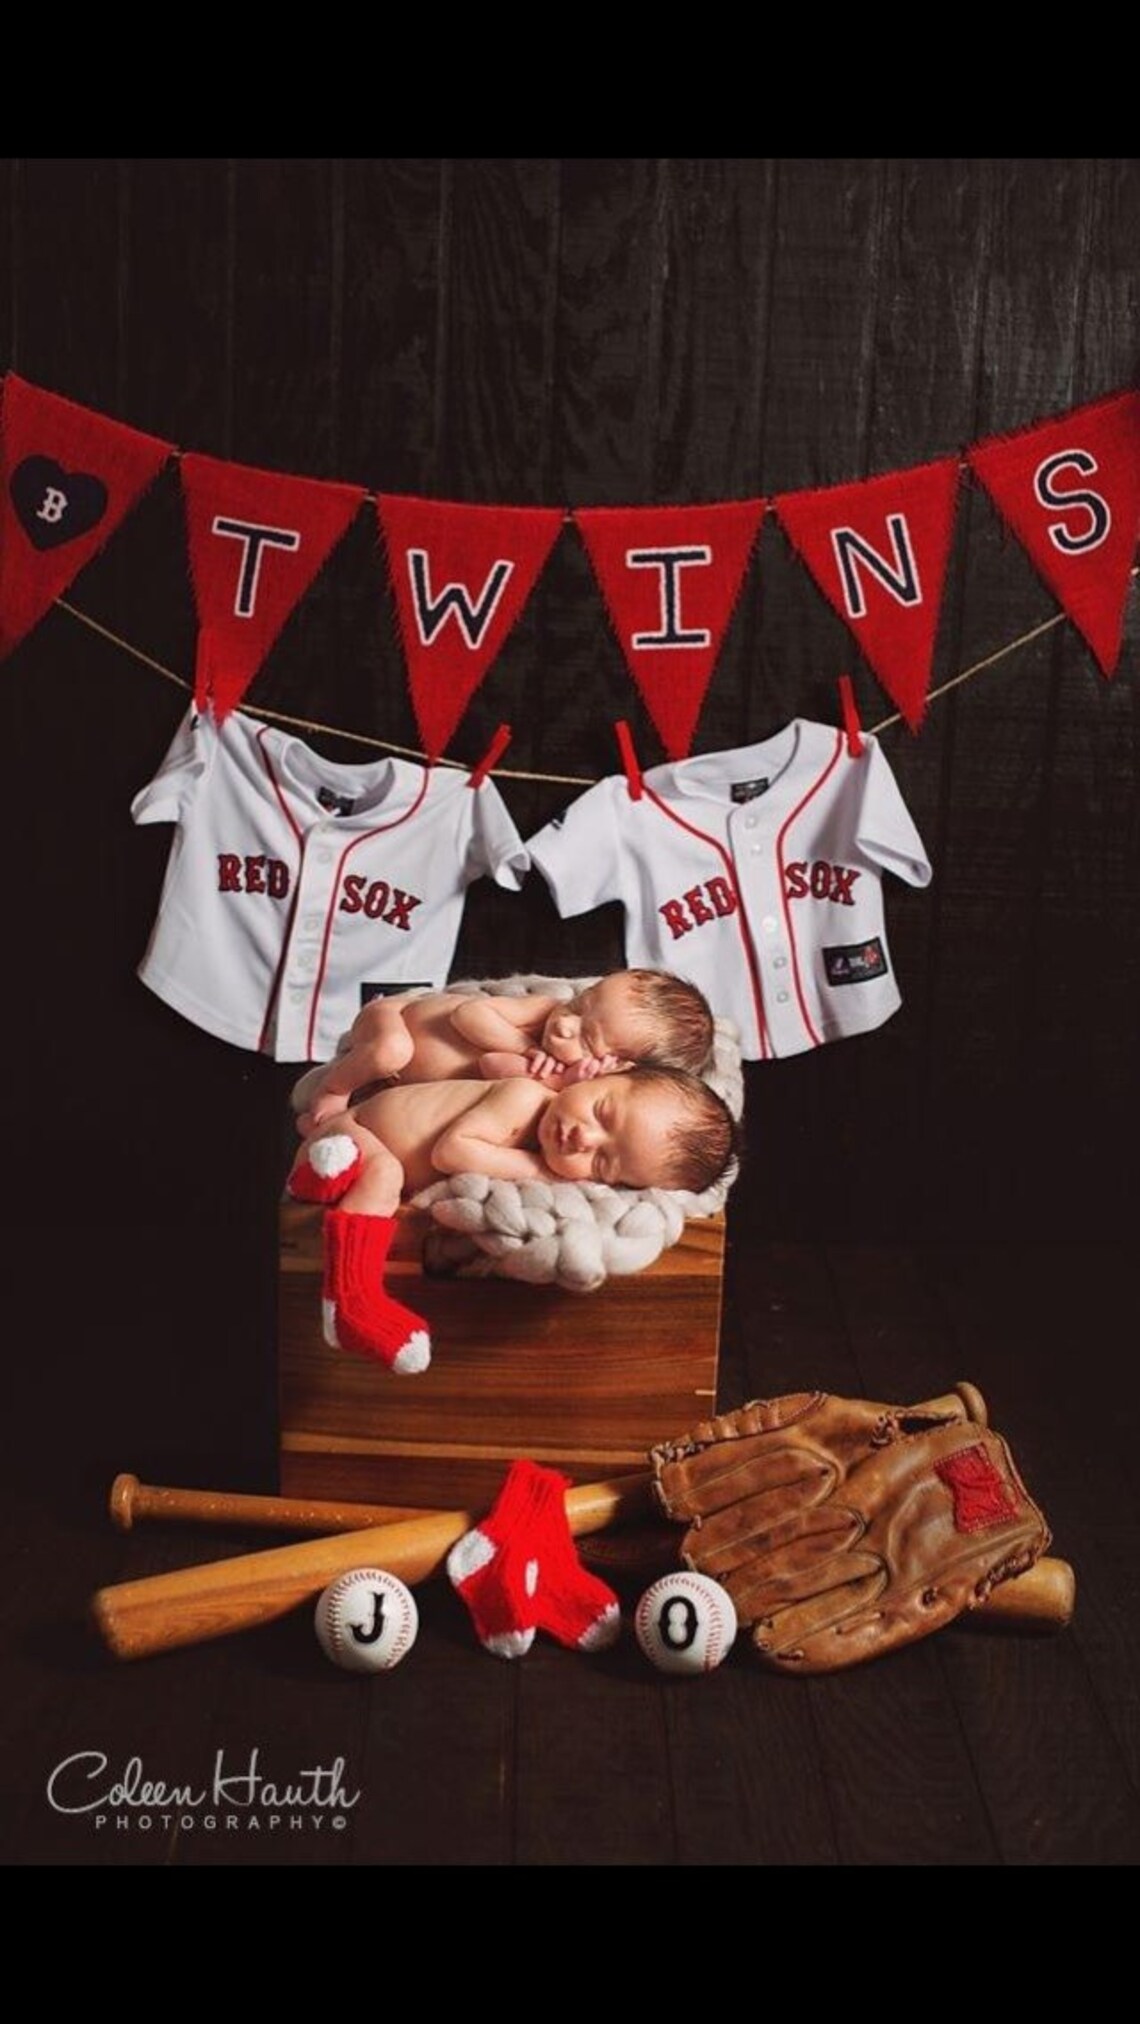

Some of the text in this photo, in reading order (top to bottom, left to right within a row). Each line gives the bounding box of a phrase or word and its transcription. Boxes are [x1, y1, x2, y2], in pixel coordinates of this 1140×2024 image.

[217, 854, 422, 931] RED SOX
[659, 861, 861, 940] RED SOX
[350, 1592, 386, 1644] J
